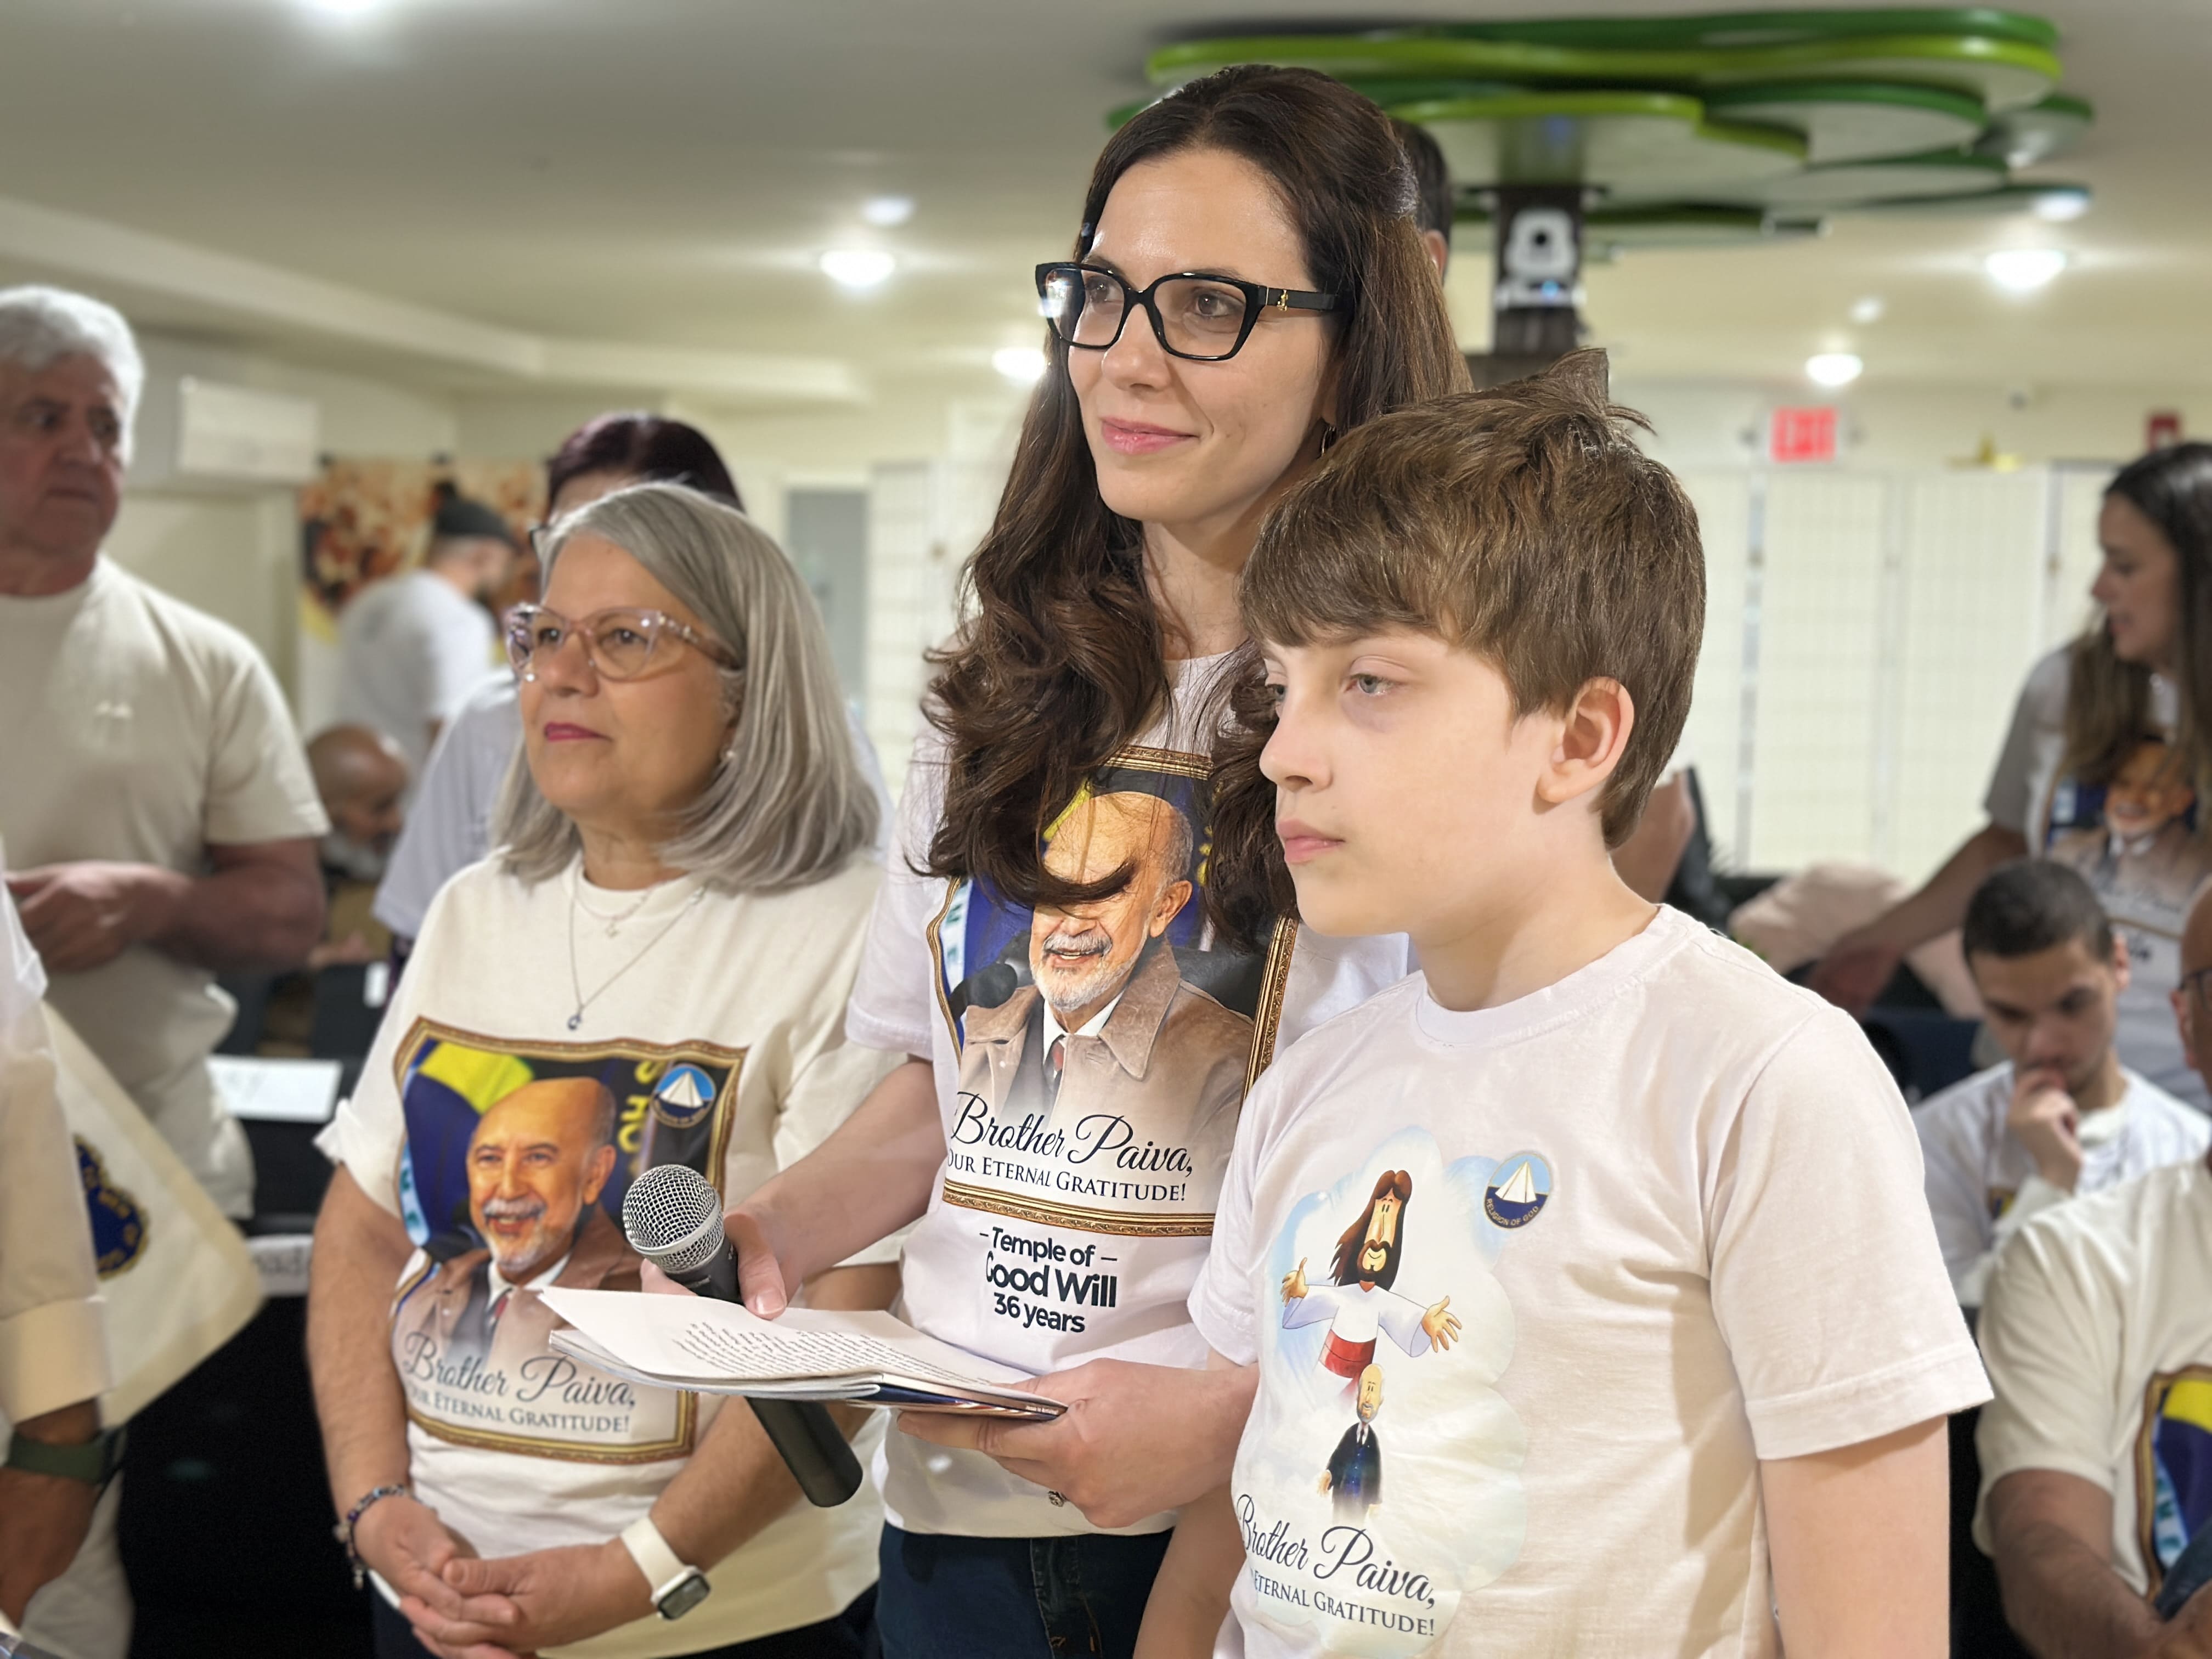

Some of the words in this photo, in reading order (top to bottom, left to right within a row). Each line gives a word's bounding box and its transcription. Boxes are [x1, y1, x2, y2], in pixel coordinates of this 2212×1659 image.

[951, 1091, 1065, 1158] Brother
[1067, 1114, 1193, 1178] Paiva,
[983, 1157, 1052, 1187] ETERNAL
[1056, 1171, 1186, 1201] GRATITUDE!
[1486, 1198, 1509, 1226] RELIGION
[1510, 1217, 1521, 1226] OF
[1522, 1205, 1539, 1222] GOD
[992, 1226, 1066, 1262] Temple
[1070, 1244, 1096, 1267] of
[1055, 1268, 1118, 1307] Will
[994, 1292, 1020, 1318] 36
[1023, 1303, 1085, 1333] years
[402, 1330, 508, 1397] Brother
[516, 1355, 635, 1410] Paiva,
[434, 1391, 505, 1422] ETERNAL
[509, 1407, 629, 1432] GRATITUDE!
[1236, 1494, 1308, 1570] Brother
[1313, 1526, 1436, 1611] Paiva,
[1314, 1592, 1435, 1637] GRATITUDE!
